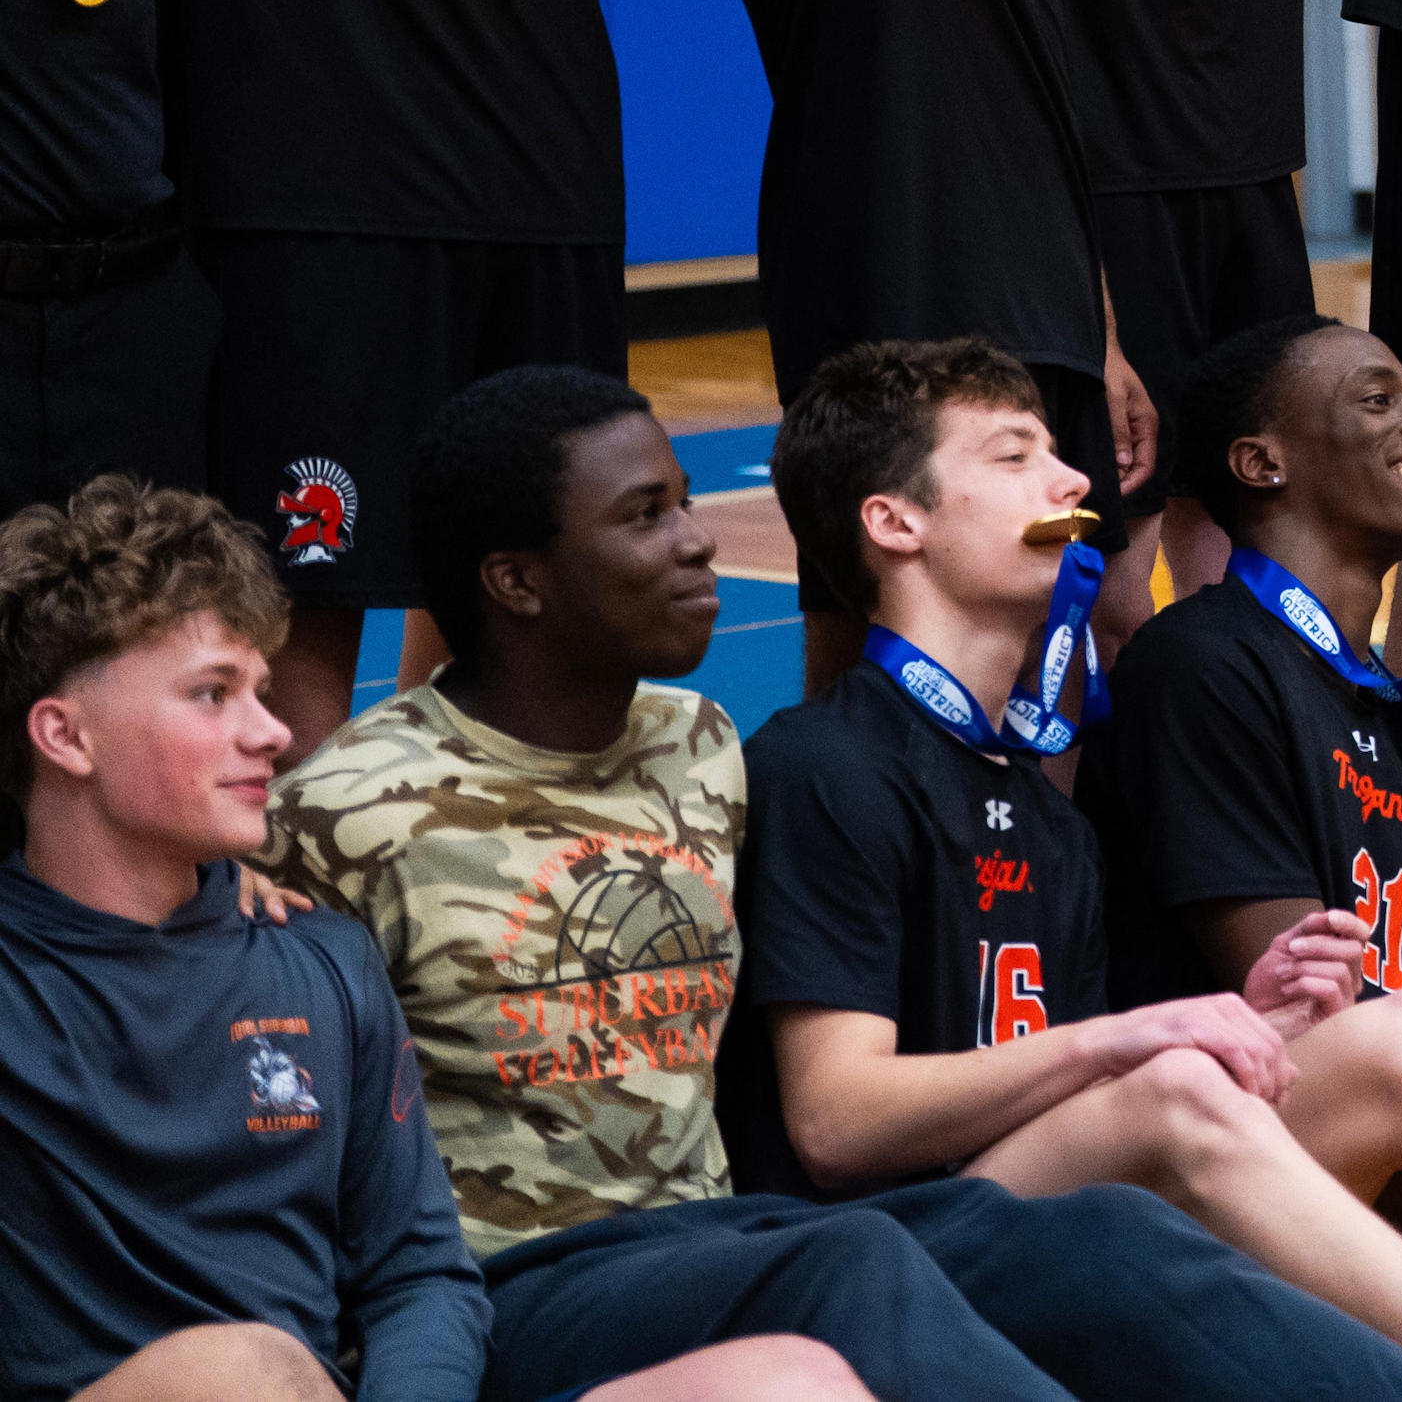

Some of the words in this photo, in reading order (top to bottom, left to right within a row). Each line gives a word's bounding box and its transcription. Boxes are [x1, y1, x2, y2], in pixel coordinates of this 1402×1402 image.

[1280, 595, 1339, 656] DISTRICT
[903, 667, 971, 726] DISTRICT
[1046, 628, 1074, 713] DISTRICT
[246, 1113, 321, 1133] VOLLEYBALL
